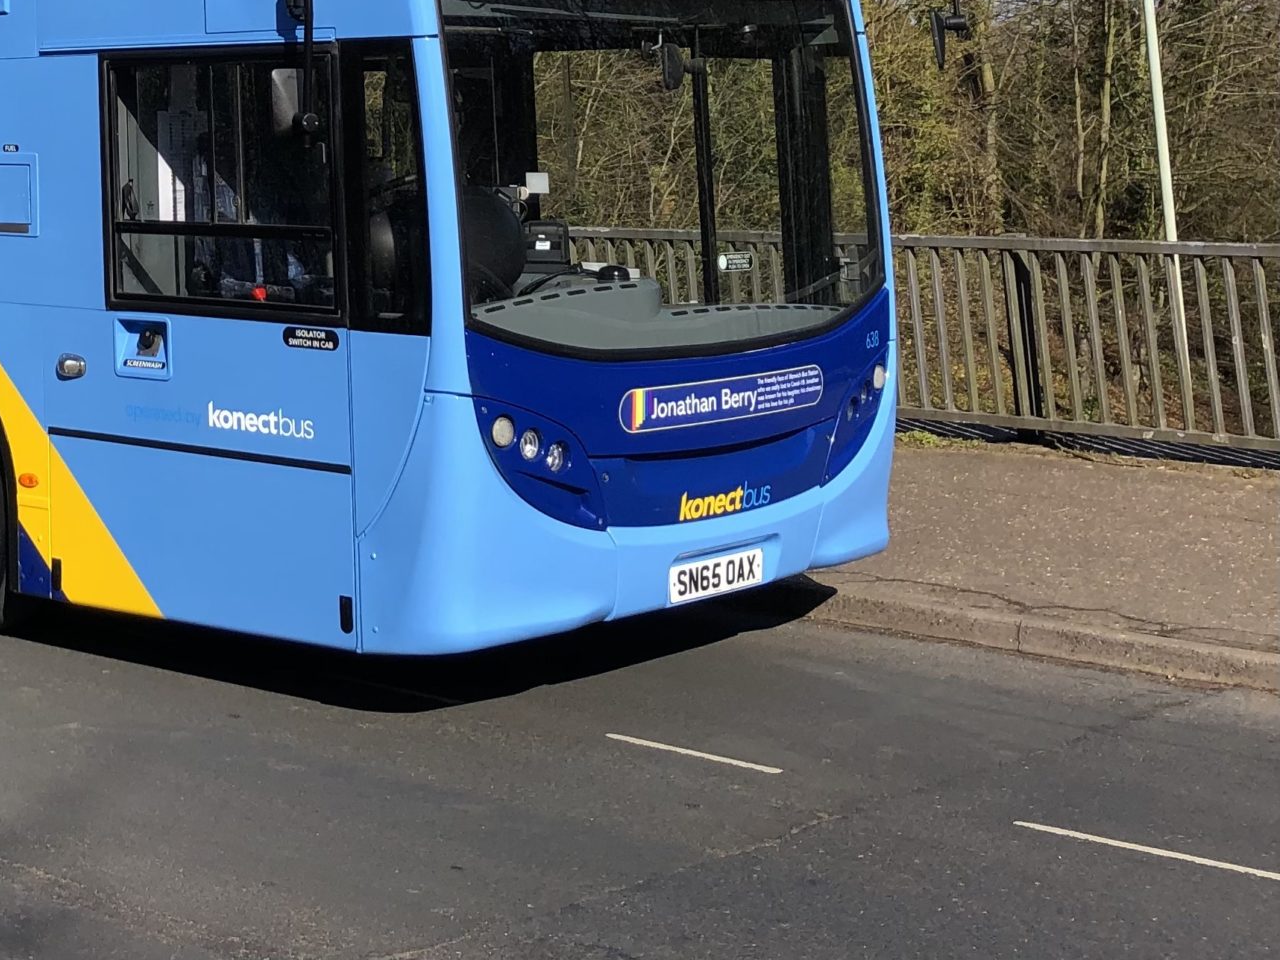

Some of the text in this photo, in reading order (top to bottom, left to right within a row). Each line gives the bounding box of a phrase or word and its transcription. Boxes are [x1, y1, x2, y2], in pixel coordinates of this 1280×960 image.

[288, 338, 334, 349] SWITCH IN CAB
[295, 329, 326, 339] ISOLATOR
[866, 330, 880, 349] 638
[126, 359, 163, 369] SCREENWASH
[651, 388, 758, 420] Jonathan Berry
[207, 400, 315, 440] konectbus
[679, 480, 772, 522] konectbus
[677, 554, 757, 597] SN65 OAX
